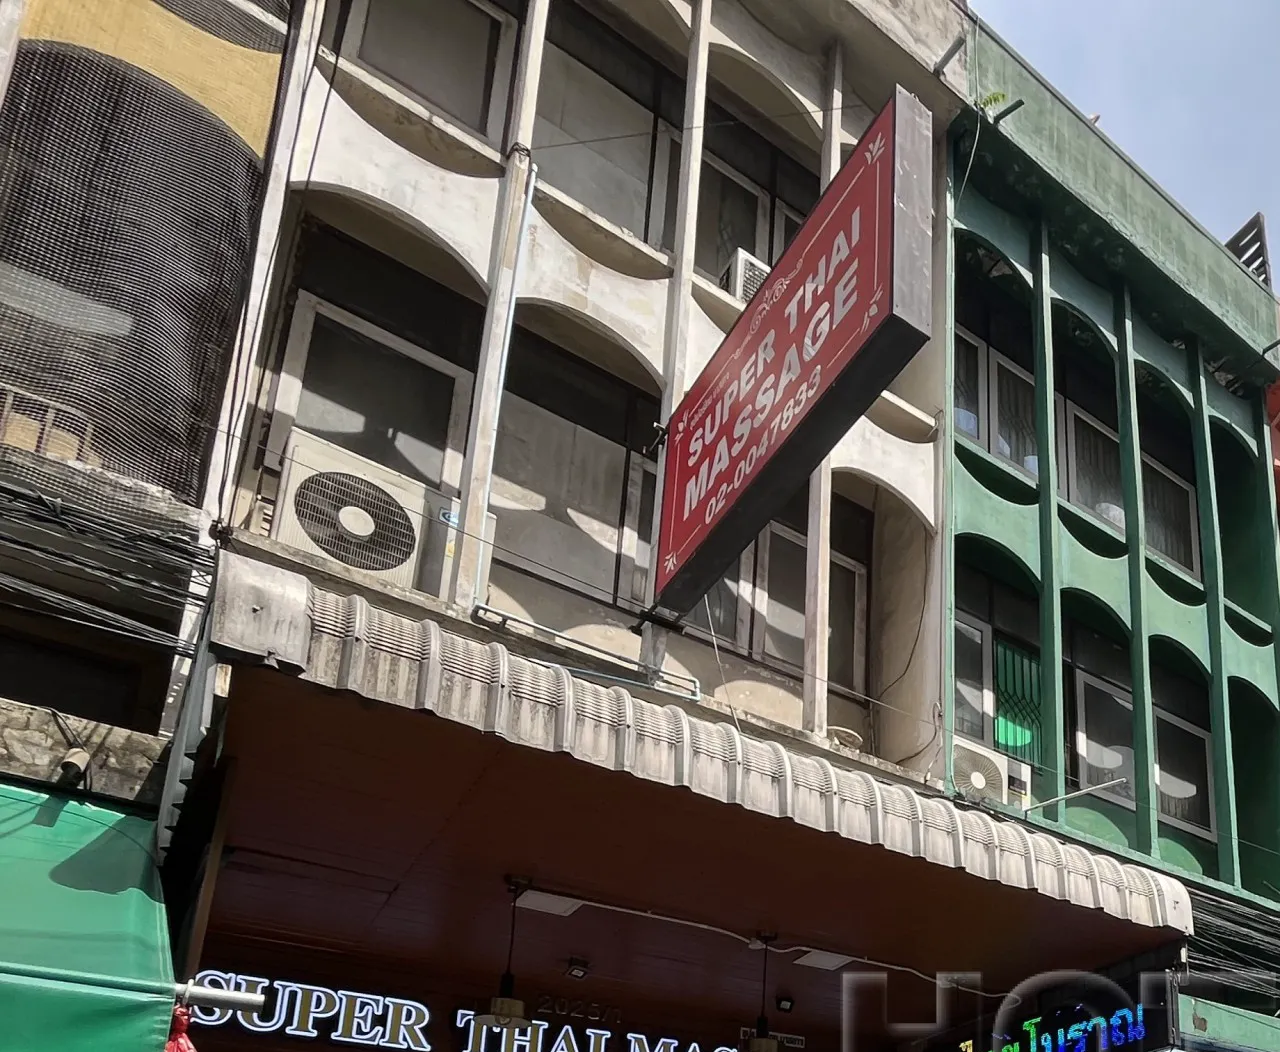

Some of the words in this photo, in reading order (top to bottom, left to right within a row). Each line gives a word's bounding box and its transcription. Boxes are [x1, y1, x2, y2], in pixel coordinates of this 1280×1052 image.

[683, 258, 859, 522] MASSAGE
[688, 329, 775, 466] SUPER
[785, 207, 861, 334] THAI
[704, 364, 822, 524] 02-0047833
[190, 969, 433, 1052] SUPER
